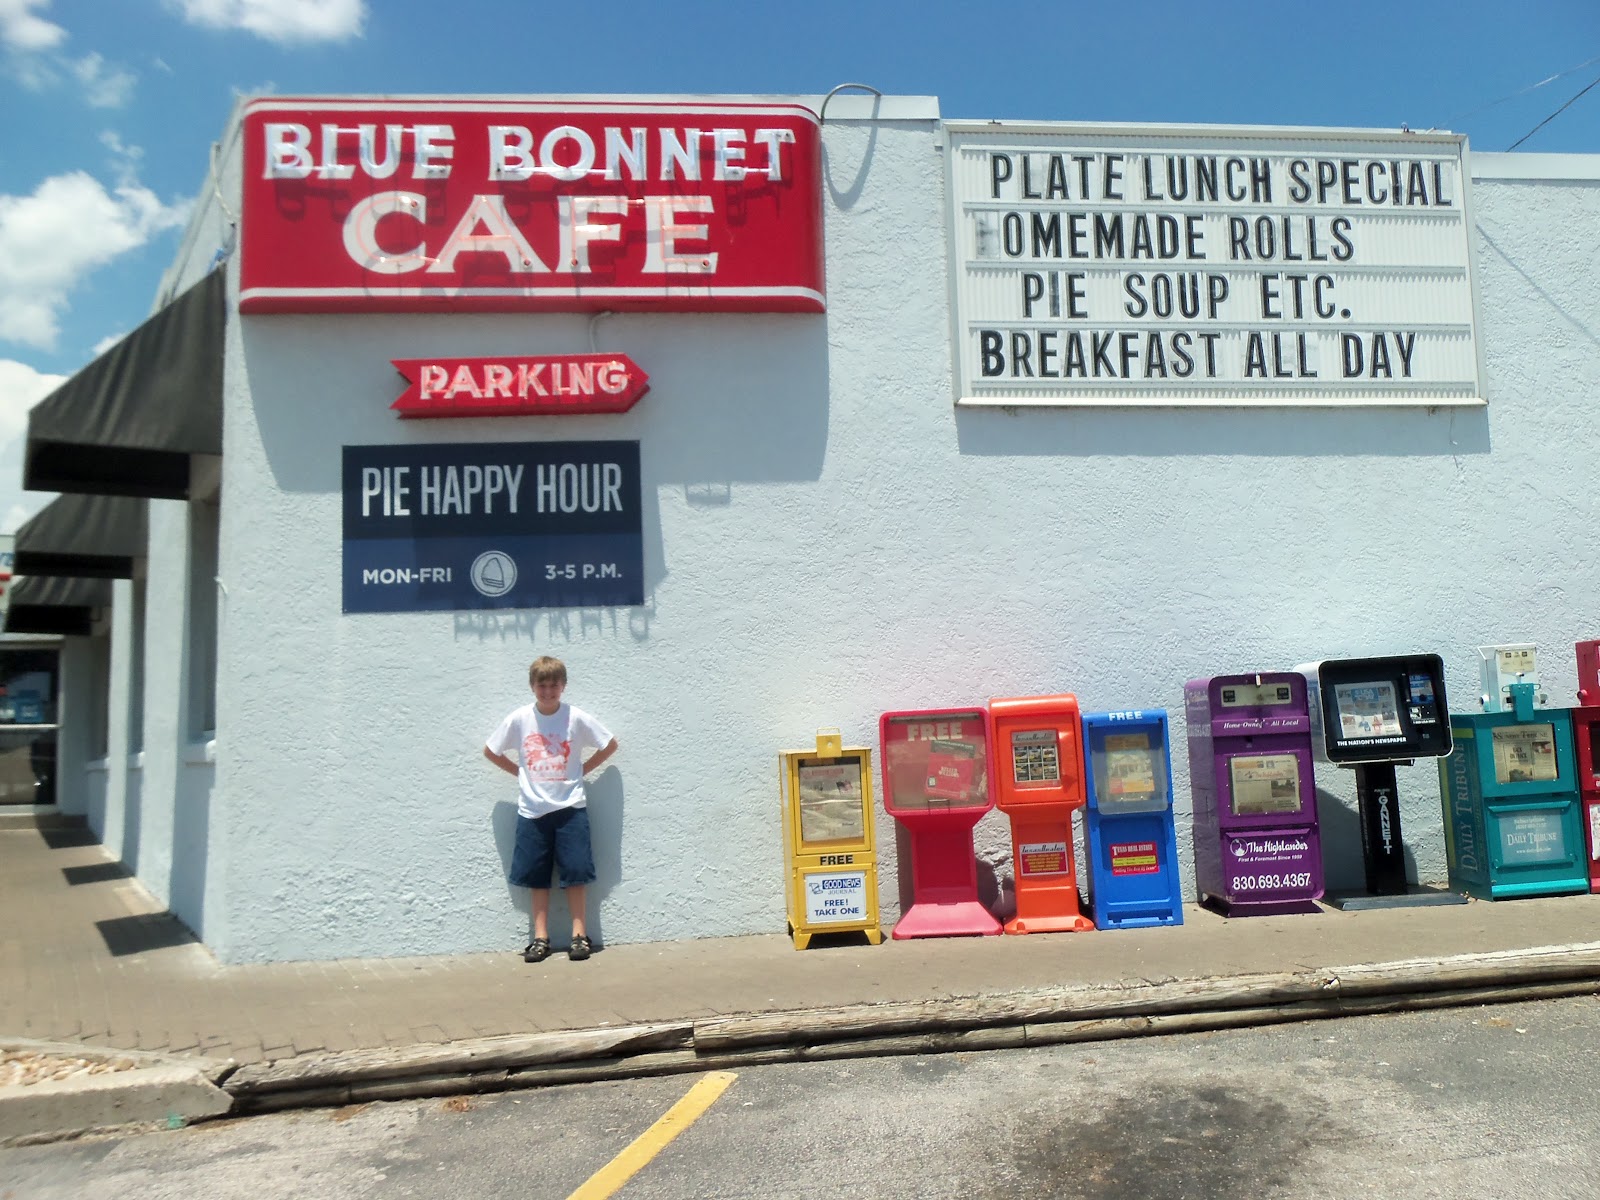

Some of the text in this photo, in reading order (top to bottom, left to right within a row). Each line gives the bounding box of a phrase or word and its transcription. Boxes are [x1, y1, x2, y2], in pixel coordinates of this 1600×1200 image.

[262, 123, 796, 182] BLUE BONNET
[989, 152, 1453, 207] PLATE LUNCH SPECIAL
[342, 190, 720, 275] CAFE
[1228, 215, 1355, 261] ROLLS
[1021, 271, 1352, 320] PIE SOUP ETC.
[979, 328, 1416, 379] BREAKFAST ALL DAY
[420, 362, 629, 401] PARKING
[361, 462, 624, 518] PIE HAPPY HOUR
[362, 563, 623, 585] MON-FRI 3-5 P.M.
[1108, 710, 1143, 721] FREE
[907, 722, 963, 742] FREE
[1453, 743, 1479, 872] DAILY TRIBUNE
[1378, 795, 1393, 855] GANNETT
[1507, 832, 1557, 846] DAILY TRIBUNE
[820, 854, 854, 866] FREE
[1247, 839, 1309, 856] The Highlander
[823, 879, 861, 890] GOOD NEWS
[1232, 872, 1311, 890] 830.693.4367
[815, 906, 860, 917] TAKE ONE
[824, 898, 849, 907] FREE!
